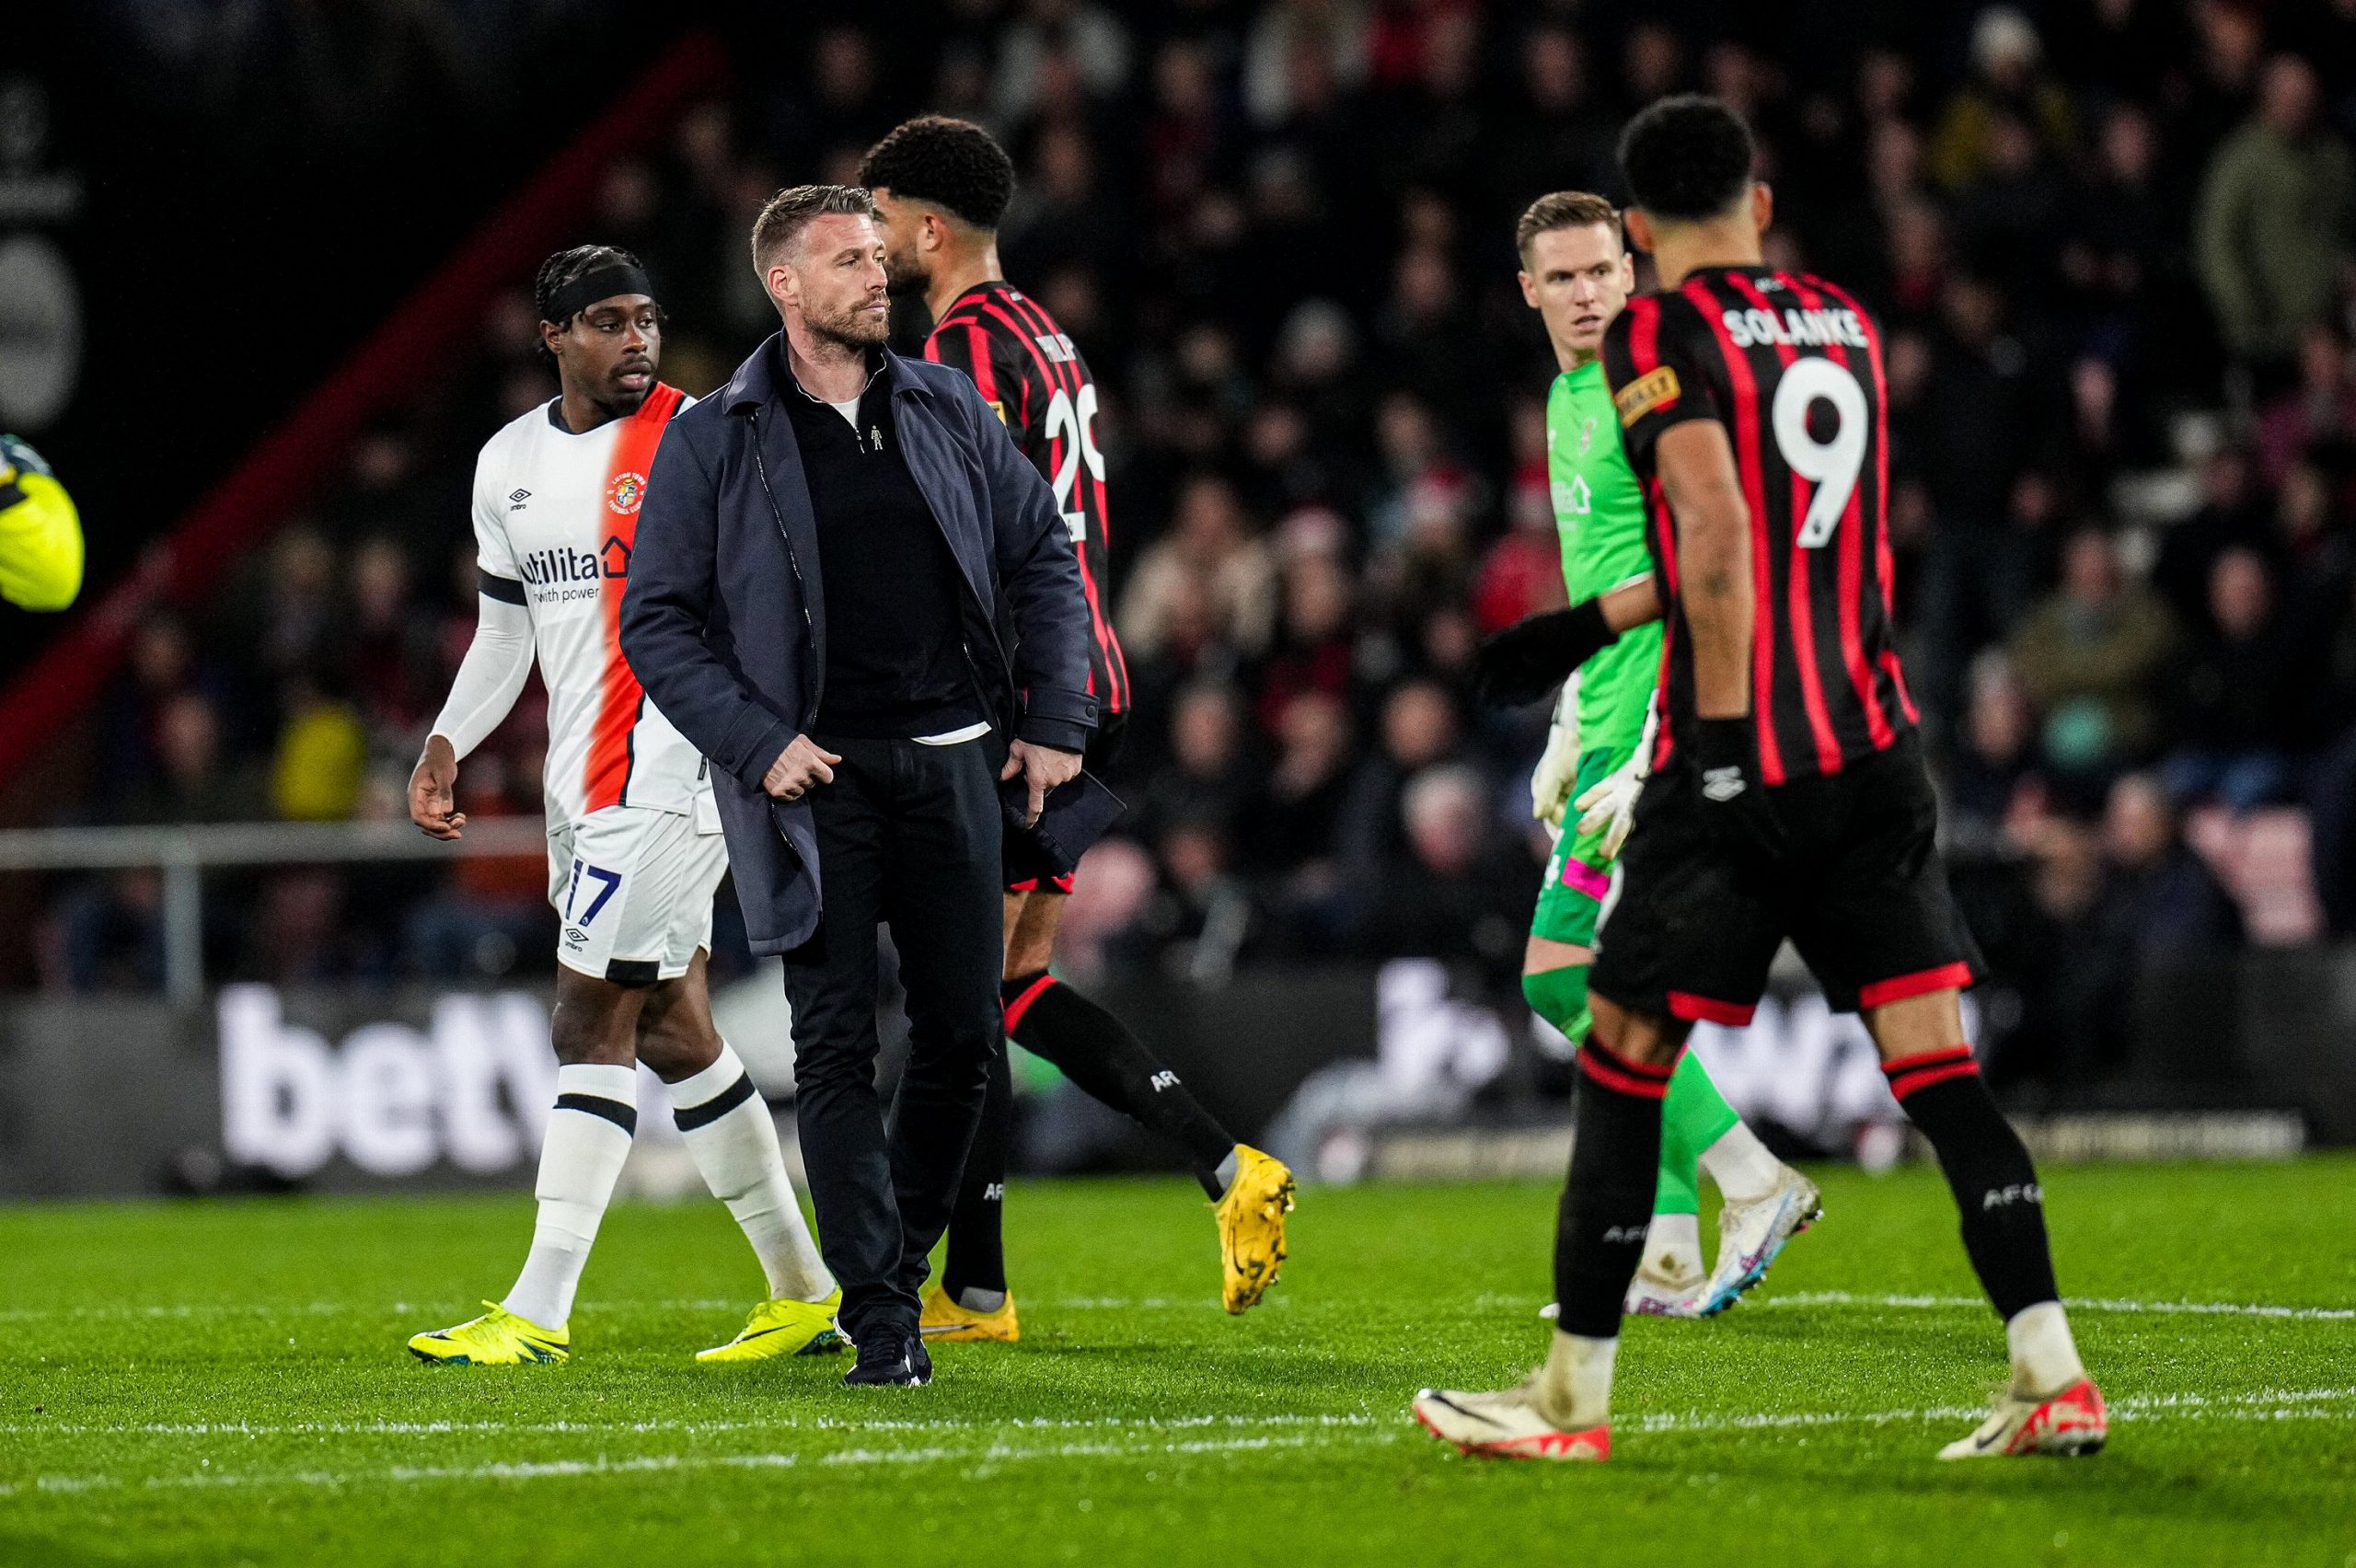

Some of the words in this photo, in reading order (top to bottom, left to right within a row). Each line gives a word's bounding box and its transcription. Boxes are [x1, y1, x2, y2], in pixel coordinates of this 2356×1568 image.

[1723, 308, 1868, 348] SOLANKE
[1773, 357, 1869, 548] 9
[519, 547, 599, 585] utilita
[561, 588, 600, 605] power
[565, 859, 622, 928] 17
